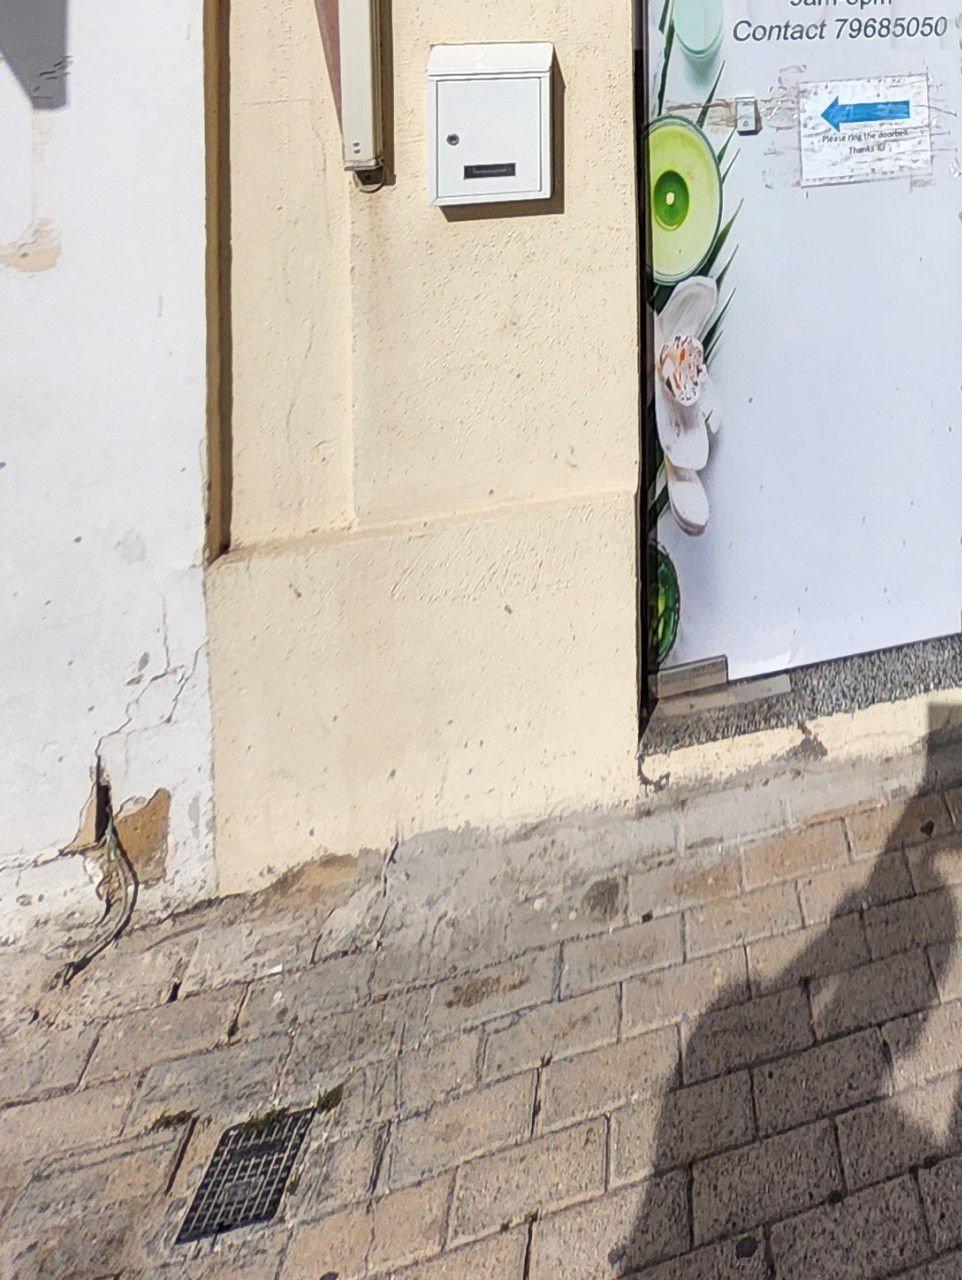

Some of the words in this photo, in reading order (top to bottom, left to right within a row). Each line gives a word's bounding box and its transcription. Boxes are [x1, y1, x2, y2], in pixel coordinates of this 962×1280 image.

[732, 19, 826, 42] Contact
[834, 16, 948, 40] 79685050
[821, 134, 847, 143] Please
[848, 133, 862, 142] ring
[863, 132, 876, 140] the
[848, 145, 875, 155] Thanks
